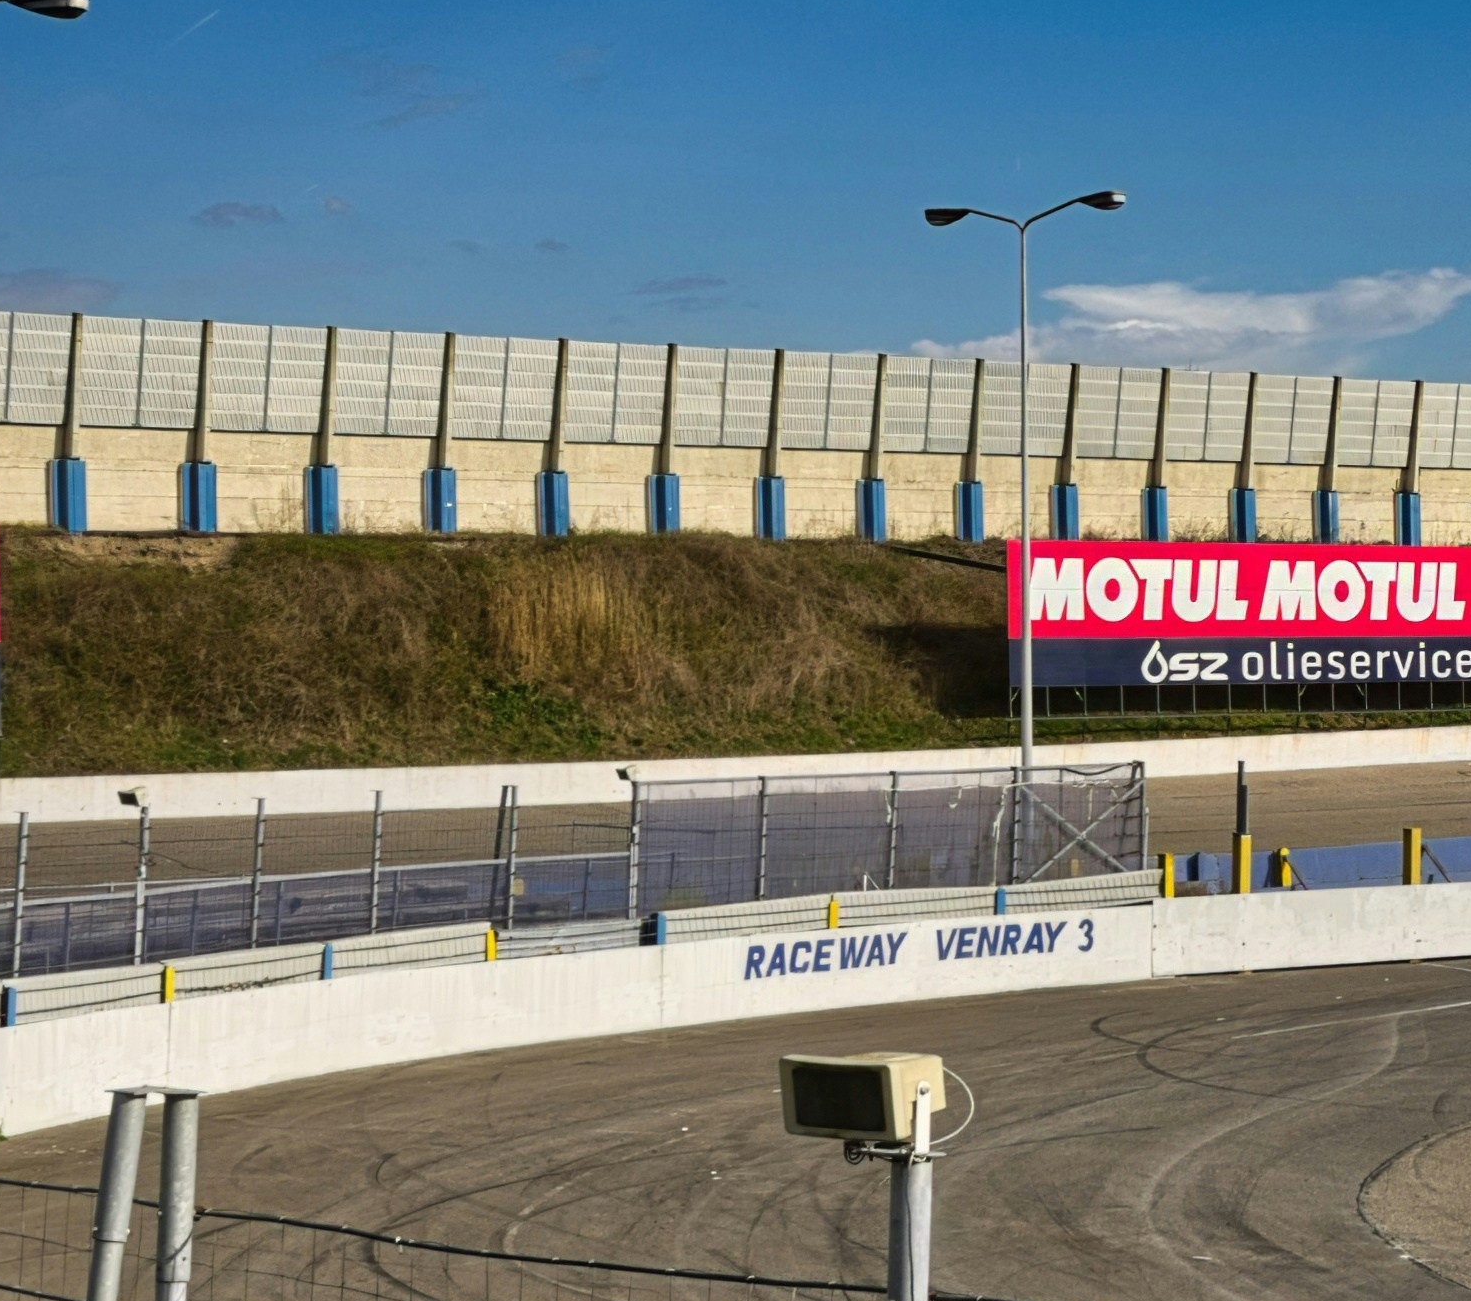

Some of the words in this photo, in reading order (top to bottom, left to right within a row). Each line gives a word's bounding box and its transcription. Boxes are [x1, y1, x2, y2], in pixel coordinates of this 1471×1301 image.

[1030, 557, 1248, 622] MOTUL
[1259, 560, 1466, 622] MOTUL
[743, 930, 909, 980] RACEWAY
[936, 920, 1068, 961] VENRAY
[1076, 918, 1095, 952] 3
